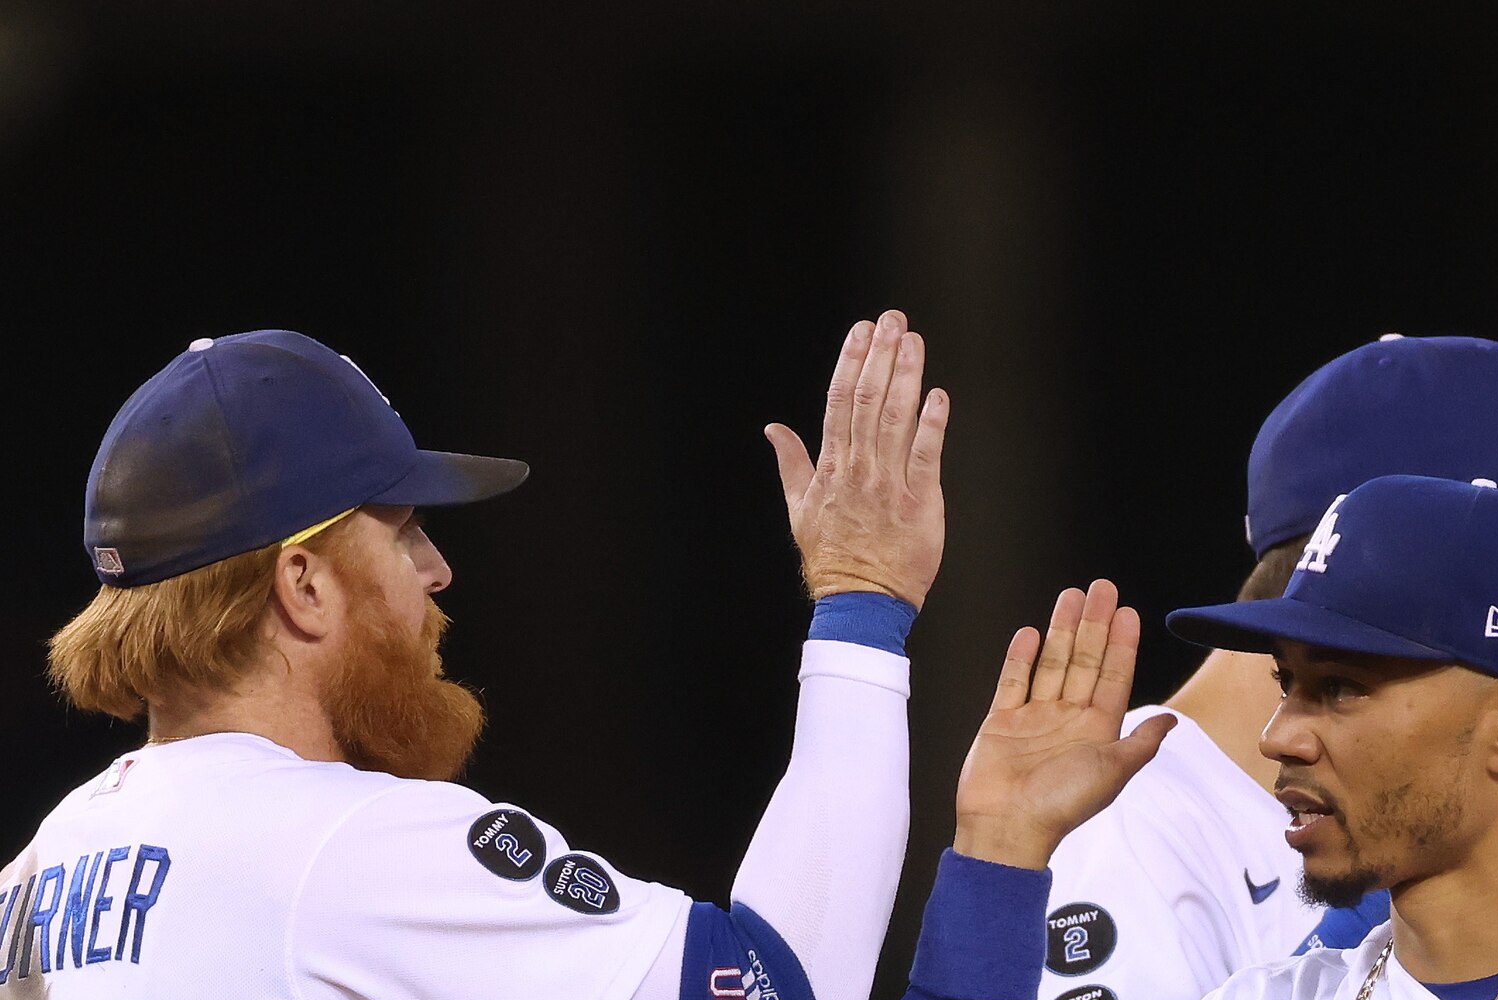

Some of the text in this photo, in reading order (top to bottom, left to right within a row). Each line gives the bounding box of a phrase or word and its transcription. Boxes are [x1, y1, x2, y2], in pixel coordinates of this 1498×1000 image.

[1296, 494, 1349, 573] LA
[473, 813, 510, 849] TOMMY
[495, 833, 532, 868] 2
[553, 859, 577, 896] SUTTON
[567, 867, 610, 909] 20
[0, 843, 171, 985] URNER
[1048, 910, 1099, 930] TOMMY
[1063, 926, 1091, 963] 2
